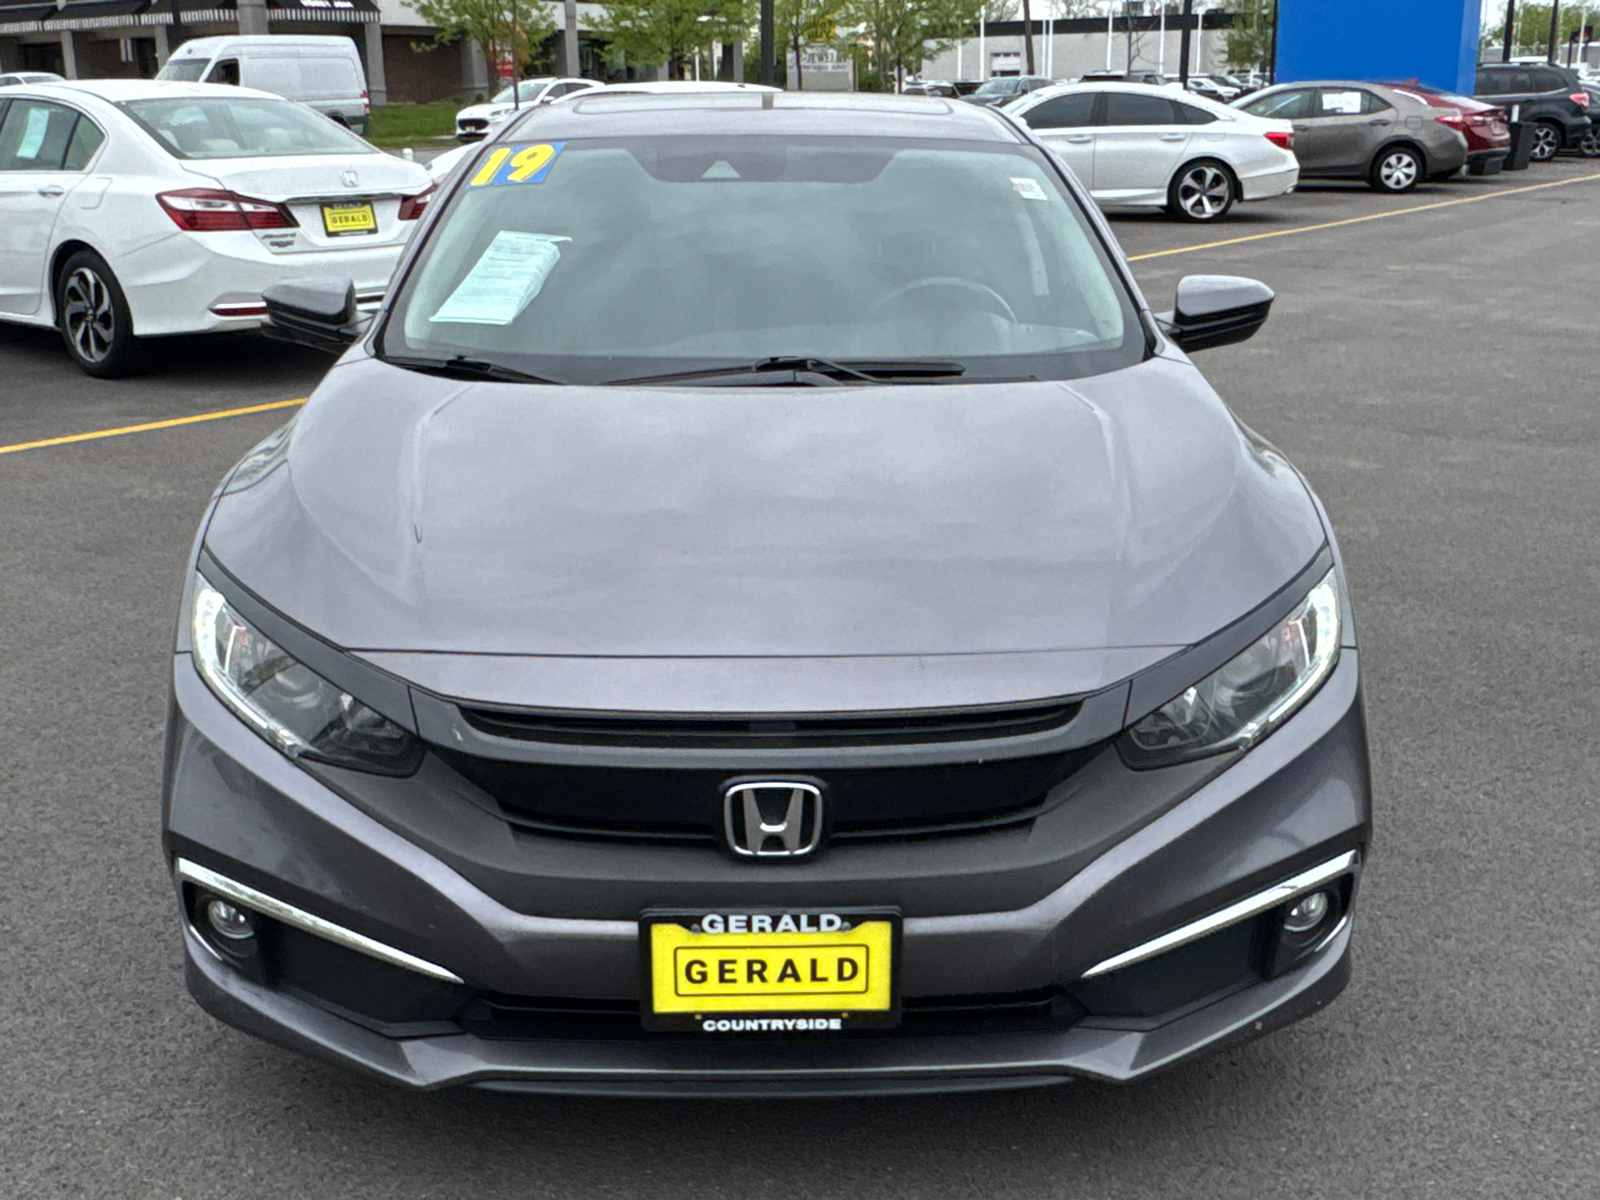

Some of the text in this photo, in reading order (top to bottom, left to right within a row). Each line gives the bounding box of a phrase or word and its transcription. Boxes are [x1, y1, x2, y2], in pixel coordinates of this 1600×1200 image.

[470, 143, 556, 186] 19
[331, 213, 368, 224] GERALD
[701, 913, 842, 934] GERALD
[684, 956, 859, 985] GERALD
[702, 1017, 842, 1032] COUNTRYSIDE
